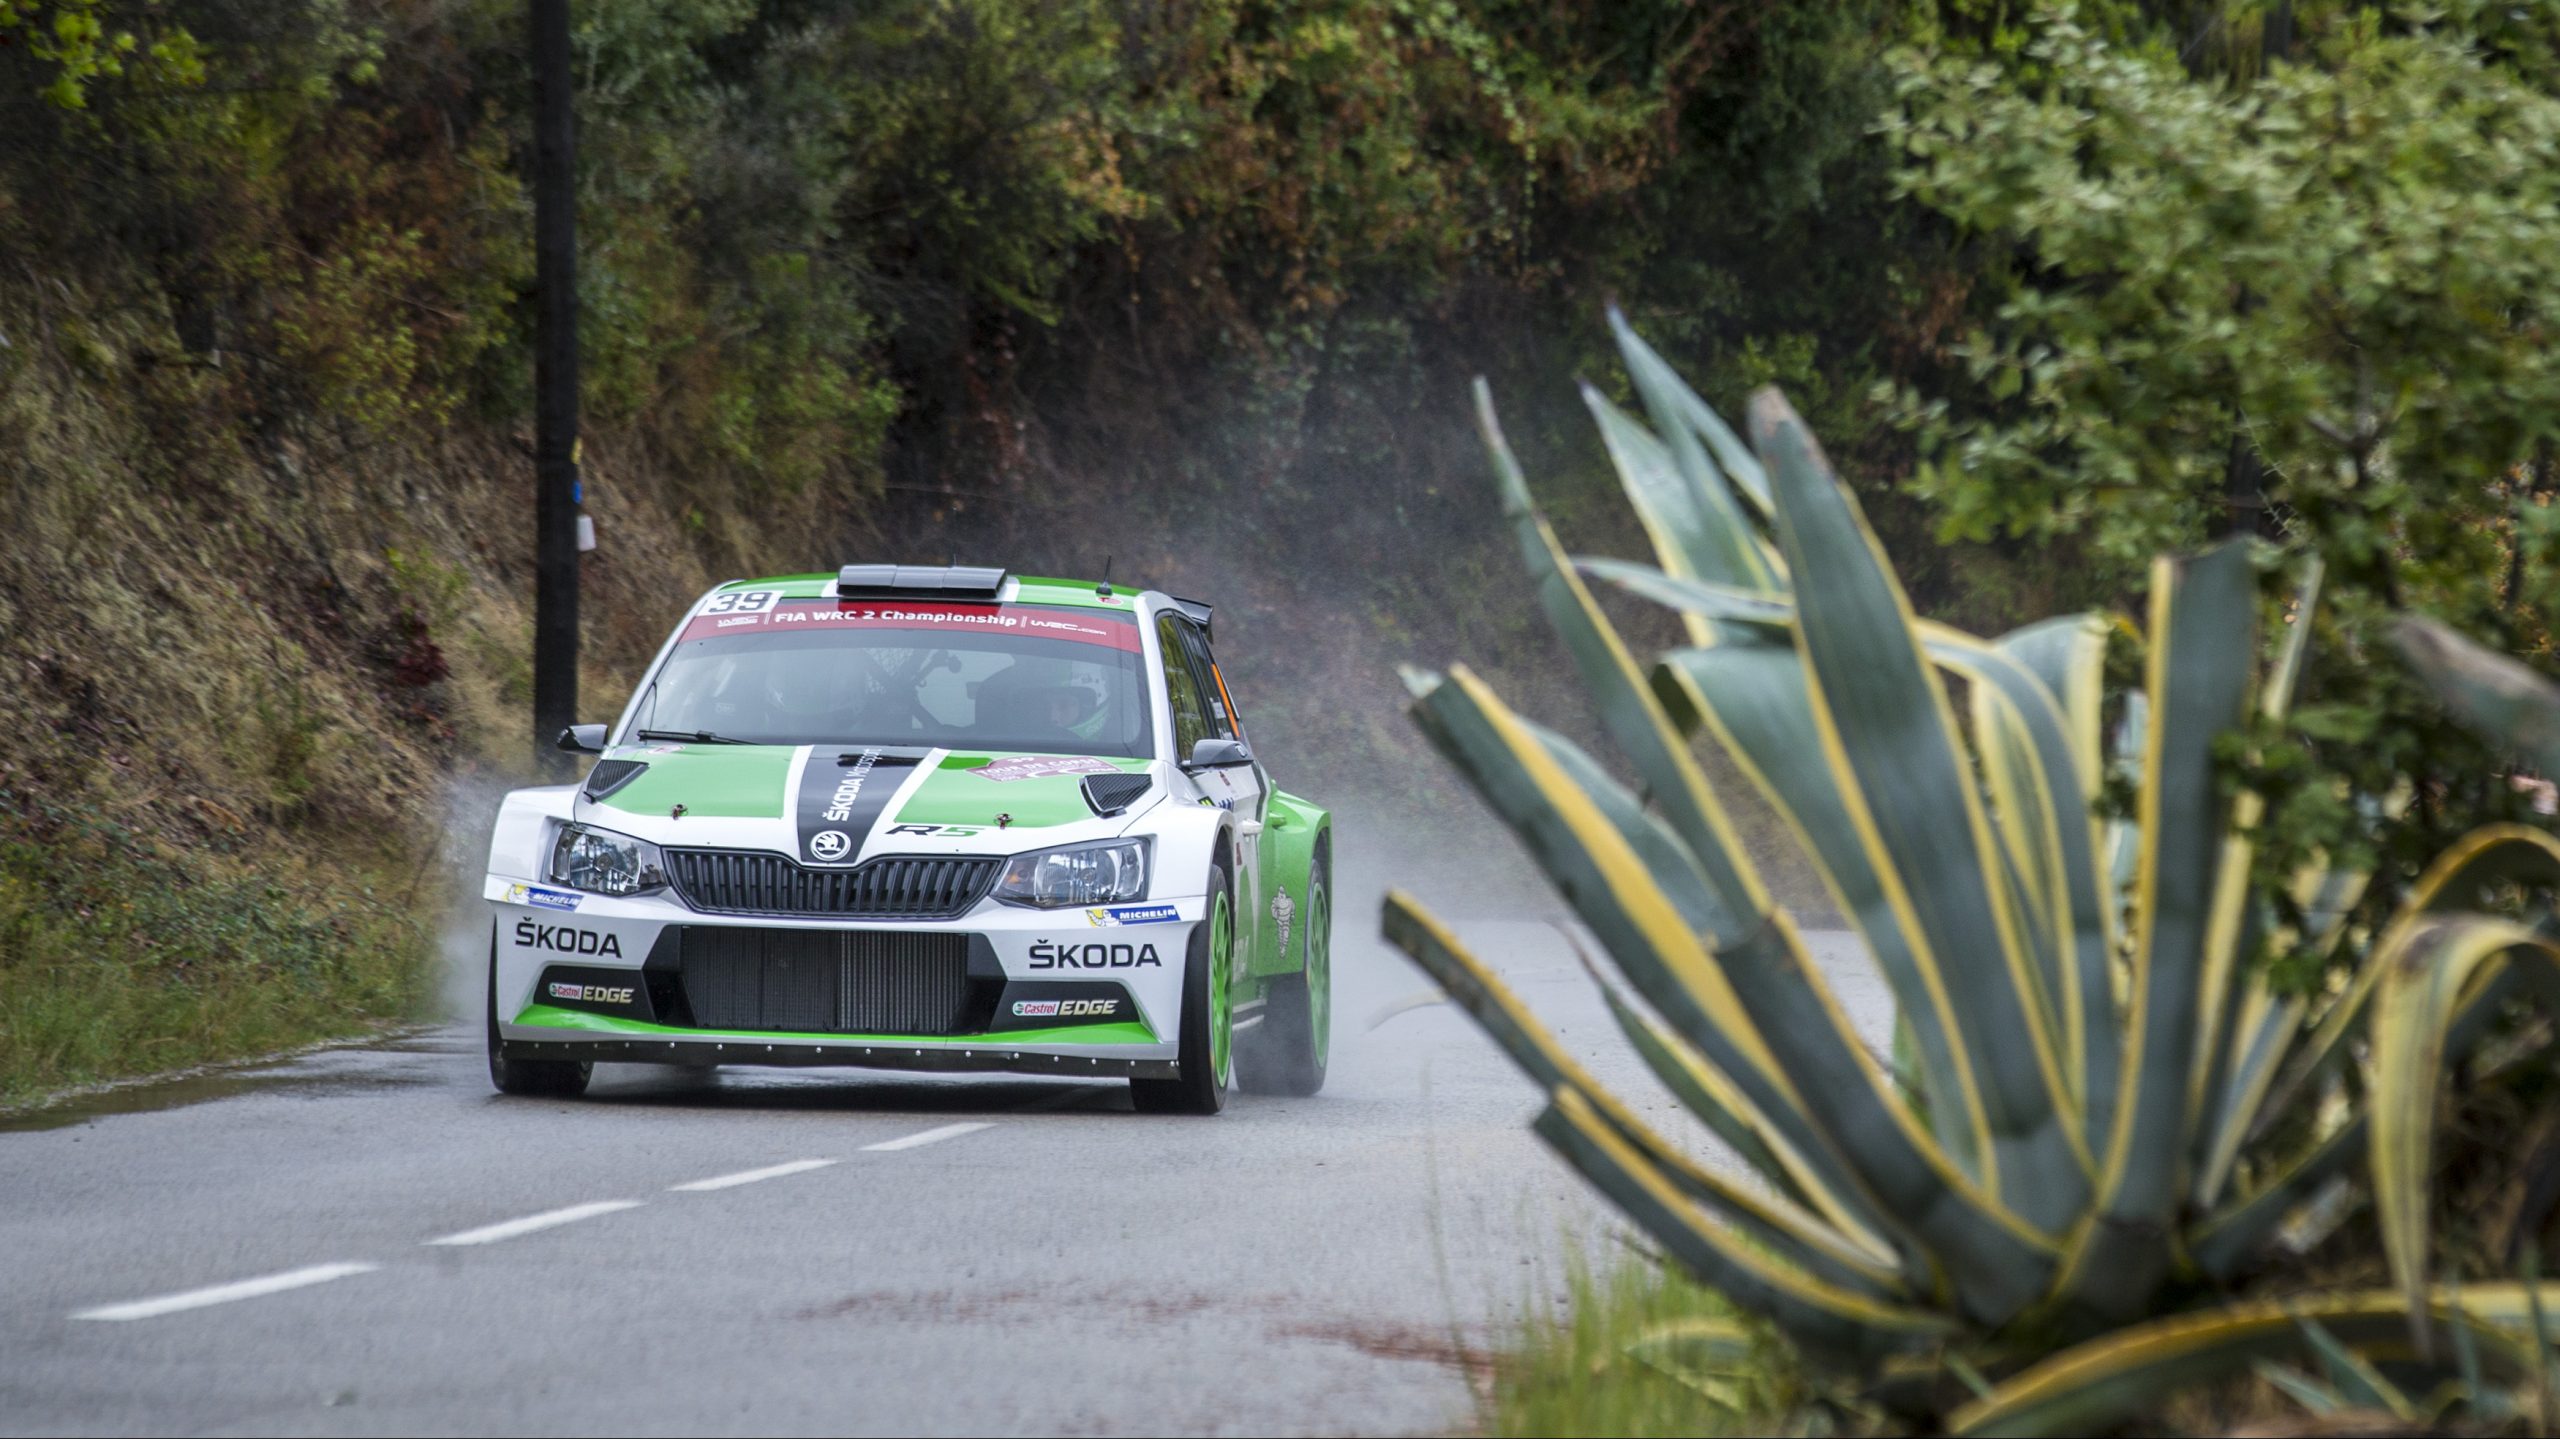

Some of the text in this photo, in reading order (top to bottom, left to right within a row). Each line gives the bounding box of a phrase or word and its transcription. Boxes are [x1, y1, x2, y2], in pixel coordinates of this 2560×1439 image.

[708, 592, 772, 613] 39
[775, 610, 1018, 627] FIA WRC 2 Championship
[822, 778, 865, 822] ŠKODA
[885, 825, 985, 837] R5
[532, 892, 580, 906] MICHELIN
[1119, 909, 1177, 919] MICHELIN
[515, 916, 622, 958] ŠKODA
[1029, 939, 1162, 969] ŠKODA
[557, 985, 635, 1004] Castrol EDGE
[1023, 1000, 1119, 1015] Castrol EDGE
